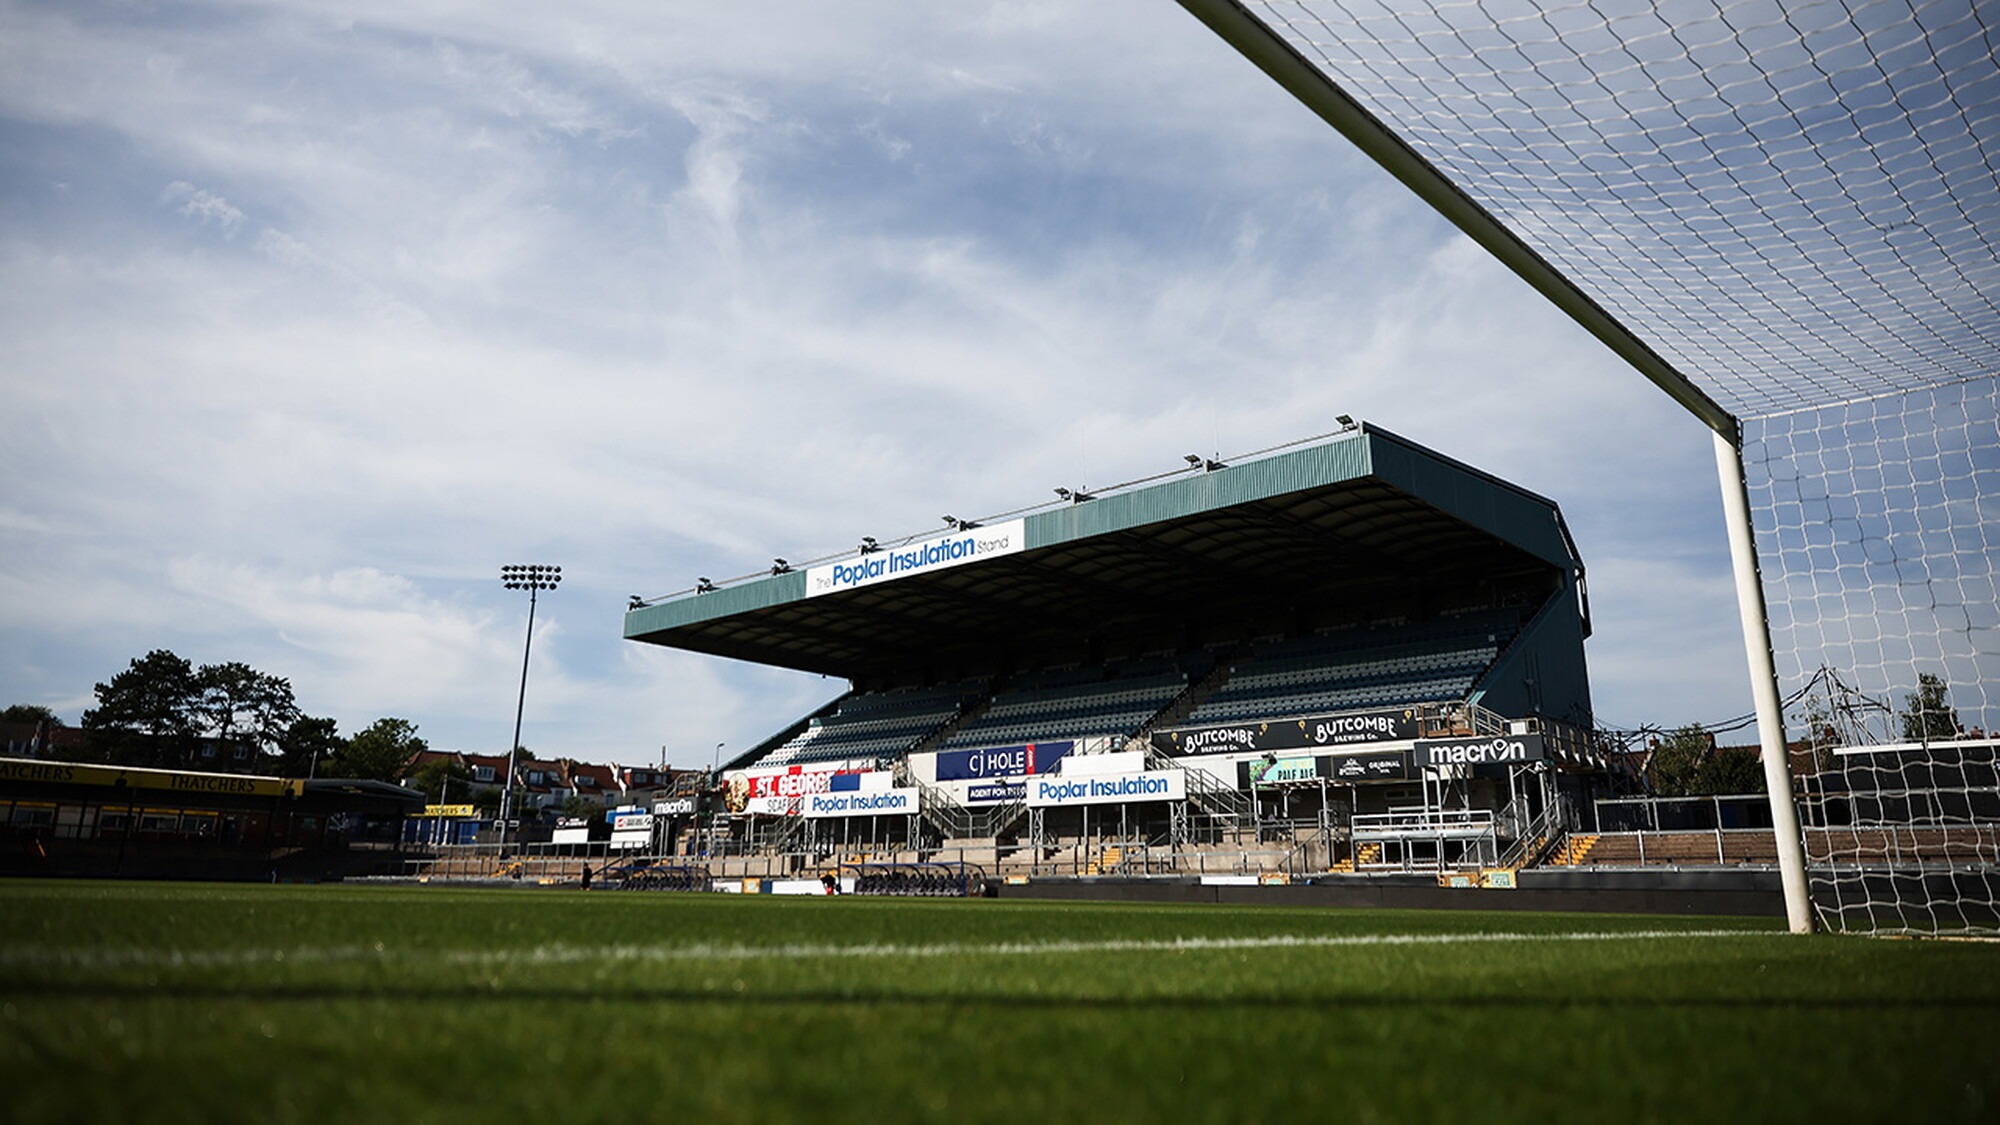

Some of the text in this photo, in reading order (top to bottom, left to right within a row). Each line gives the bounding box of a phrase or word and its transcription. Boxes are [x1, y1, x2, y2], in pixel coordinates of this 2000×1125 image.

[816, 536, 1009, 589] The Poplar Insulation Stand
[1184, 729, 1256, 753] BUTCOMBE
[1314, 717, 1397, 743] BUTCOMBE
[988, 751, 1025, 770] HOLE
[1429, 739, 1526, 763] macron
[169, 774, 256, 792] THATCHERS
[756, 776, 776, 797] ST.
[1039, 780, 1089, 802] Poplar
[1091, 776, 1168, 797] Insulation
[654, 799, 692, 815] macron
[812, 792, 906, 814] Poplar Insulation
